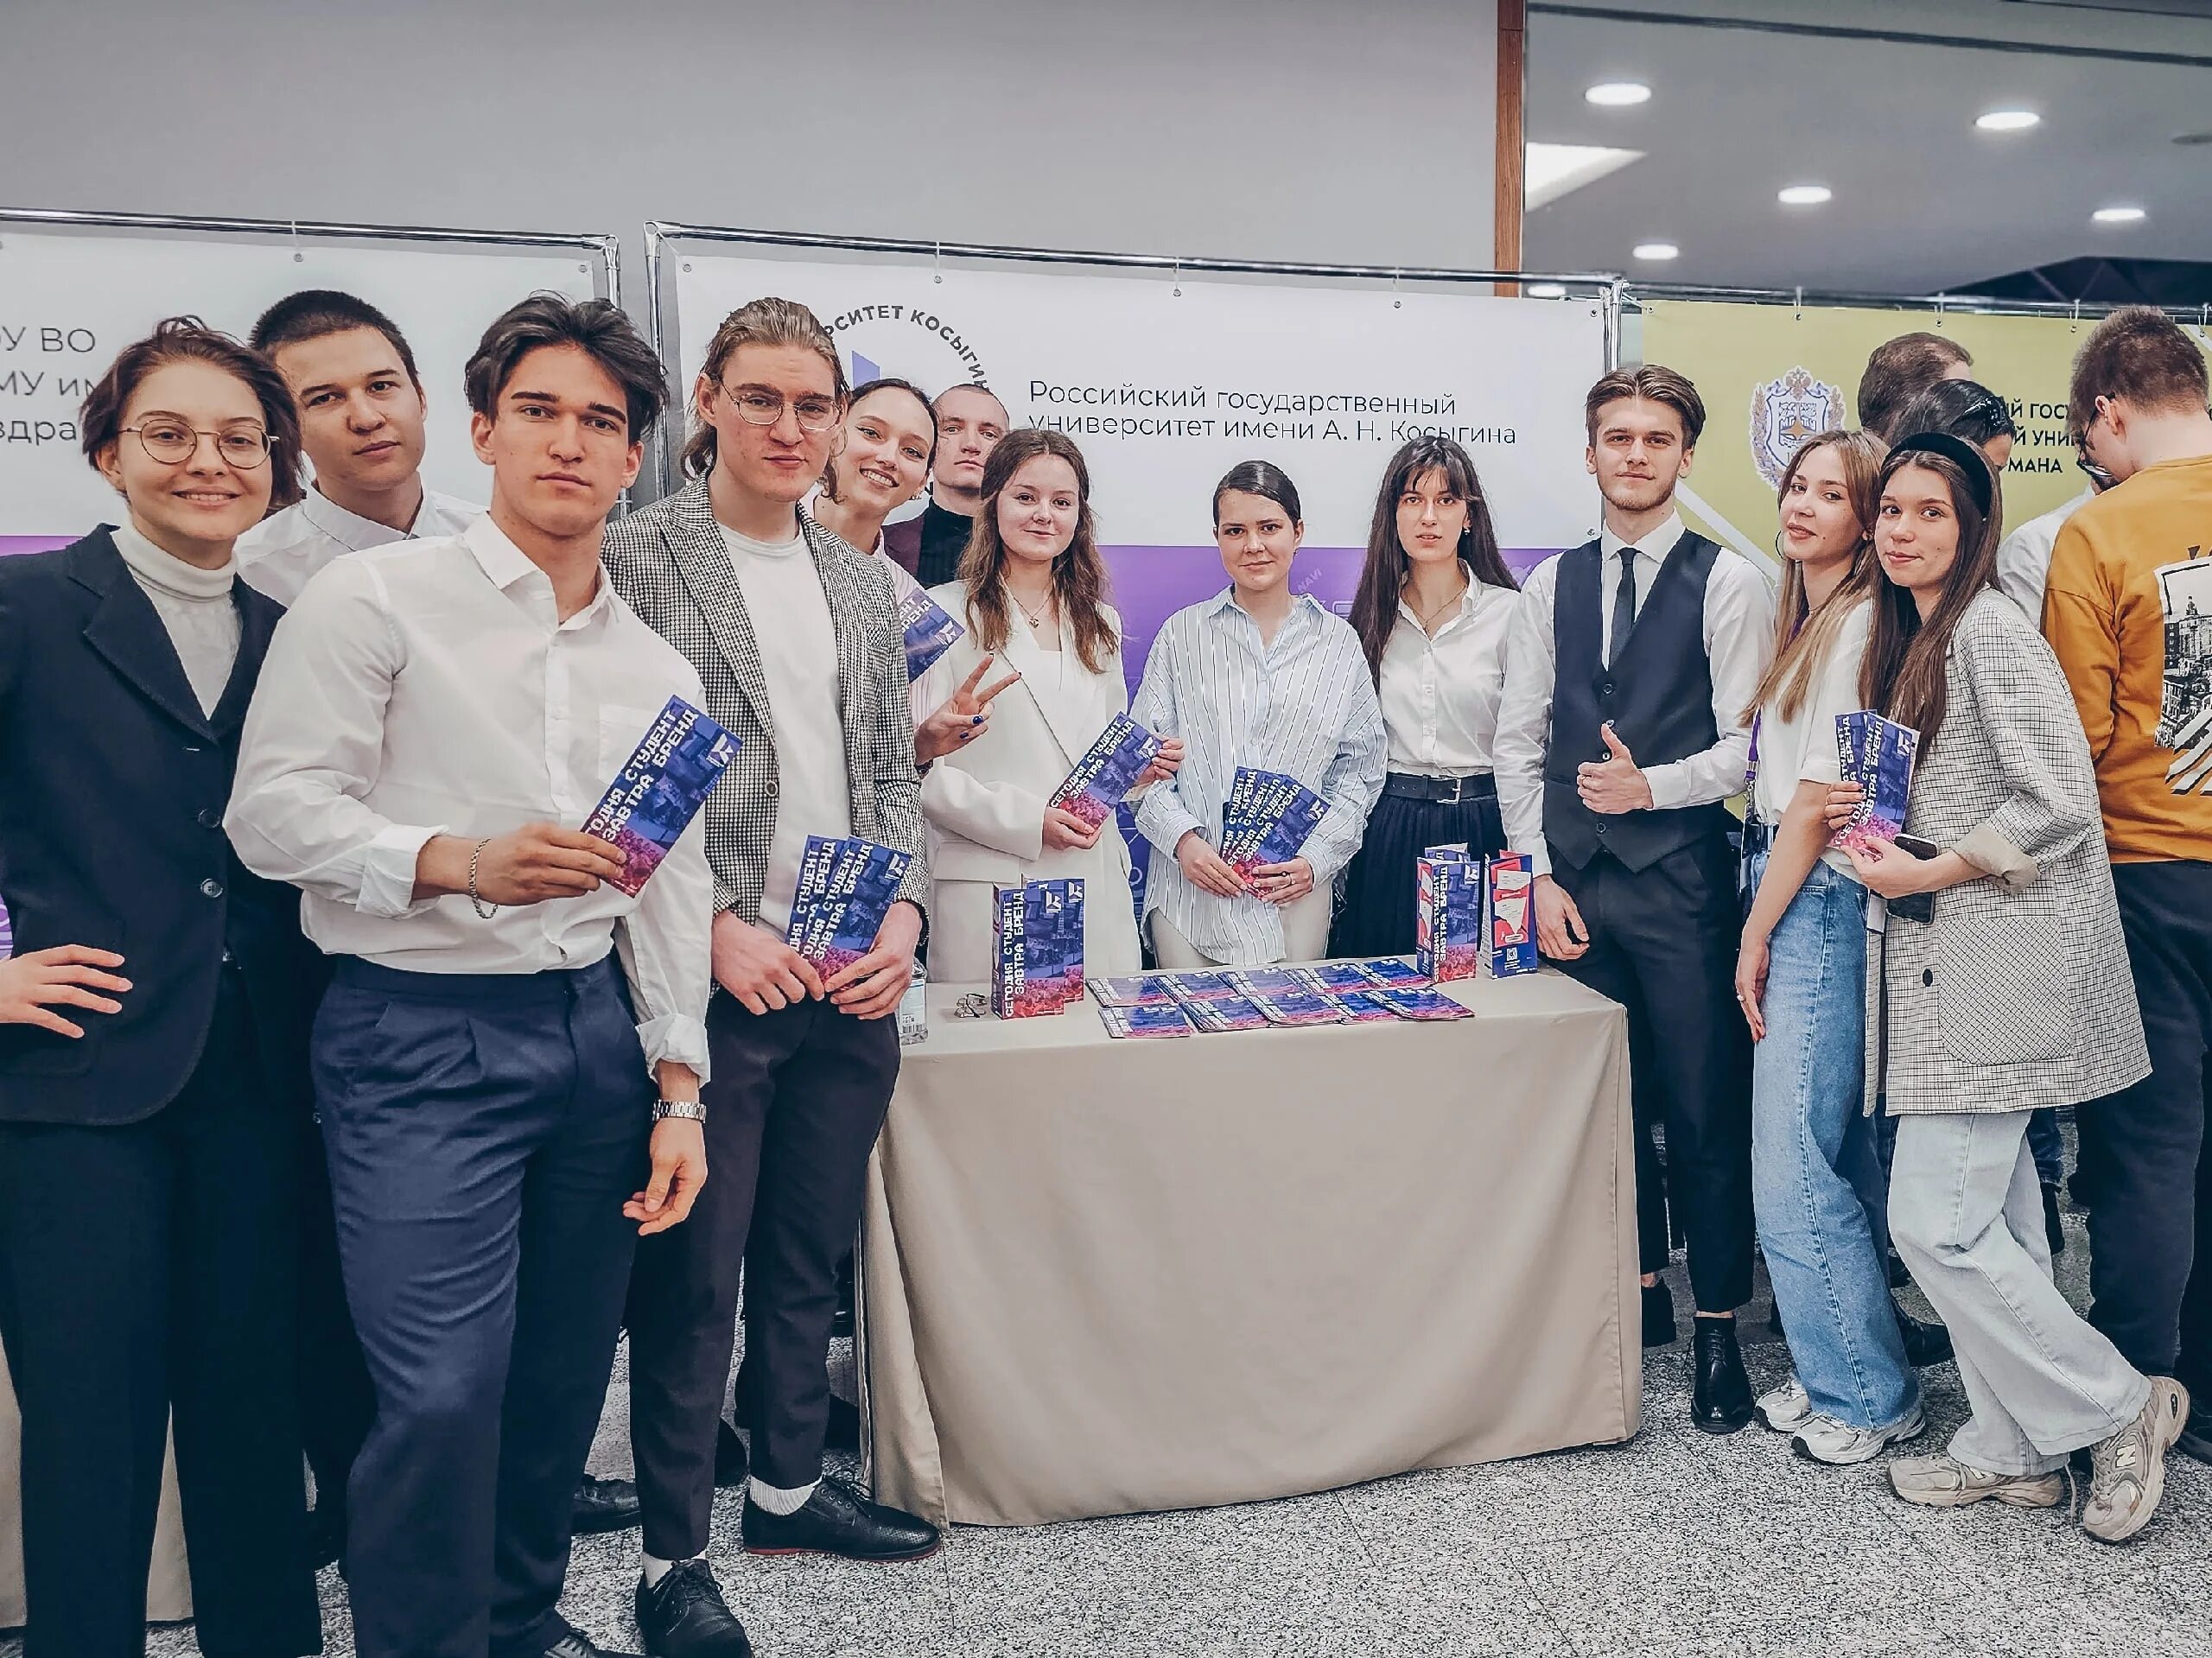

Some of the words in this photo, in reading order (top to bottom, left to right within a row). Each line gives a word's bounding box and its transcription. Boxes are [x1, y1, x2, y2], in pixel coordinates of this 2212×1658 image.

[41, 327, 96, 353] ВО
[1030, 380, 1206, 408] Российский
[1217, 391, 1456, 416] государственный
[1028, 415, 1216, 440] университет
[1224, 421, 1314, 440] имени
[1322, 419, 1348, 441] А.
[1357, 420, 1382, 441] Н.
[1391, 420, 1516, 444] Косыгина
[2007, 457, 2063, 473] МАНА
[625, 709, 677, 782] СТУДЕНТ
[1050, 765, 1087, 809] СЕГОДНЯ
[1086, 720, 1122, 764] СТУДЕНТ
[1070, 759, 1105, 799] ЗАВТРА
[1103, 720, 1135, 756] БРЕНД
[1859, 773, 1878, 825] ЗАВТРА
[1871, 721, 1884, 767] БРЕНД
[1862, 722, 1874, 781] СТУДЕНТ
[602, 773, 655, 842] ЗАВТРА
[652, 708, 700, 768] БРЕНД
[1228, 775, 1245, 825] СТУДЕНТ
[1243, 780, 1269, 827] СТУДЕНТ
[1243, 822, 1274, 861] ЗАВТРА
[1273, 784, 1303, 819] БРЕНД
[1256, 785, 1289, 826] СТУДЕНТ
[796, 848, 819, 914] СТУДЕНТ
[813, 842, 836, 894] БРЕНД
[822, 848, 855, 913] СТУДЕНТ
[813, 902, 848, 961] ЗАВТРА
[842, 843, 874, 895] БРЕНД
[1003, 900, 1013, 956] СТУДЕНТ
[1014, 891, 1025, 936] БРЕНД
[1004, 962, 1014, 1017] СЕГОДНЯ
[1014, 942, 1025, 994] ЗАВТРА
